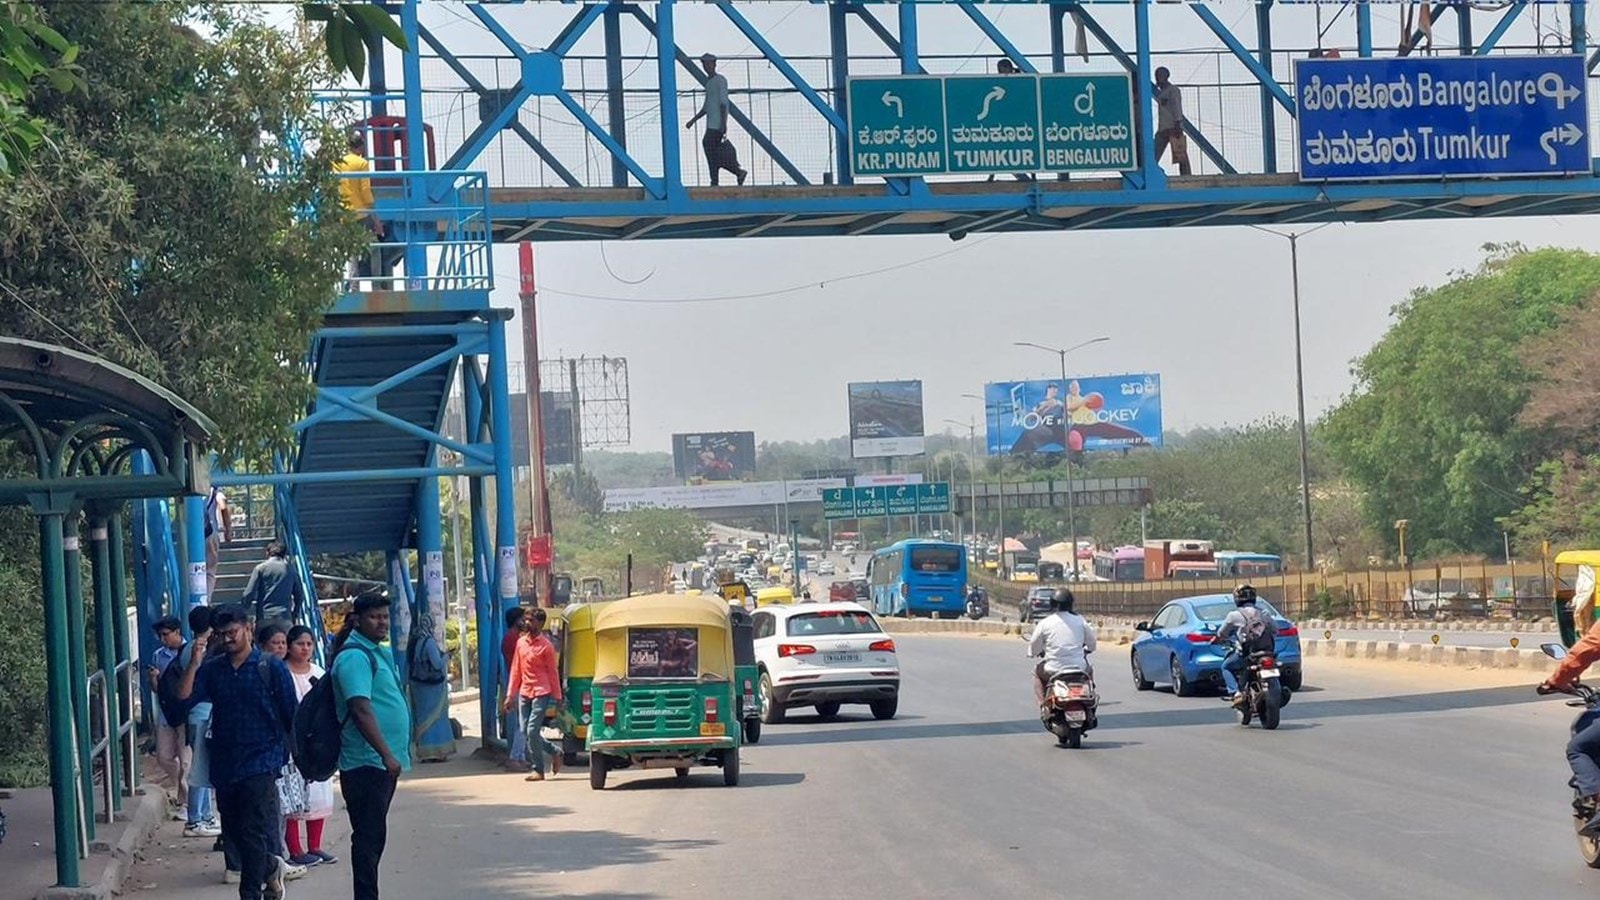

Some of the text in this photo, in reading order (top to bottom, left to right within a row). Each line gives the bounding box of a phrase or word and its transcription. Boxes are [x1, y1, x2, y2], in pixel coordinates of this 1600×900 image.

[1303, 72, 1537, 112] ಬೆಂಗಳೂರು Bangalore
[952, 123, 1034, 143] ತುಮಕೂರು
[1046, 121, 1128, 142] ಬೆಂಗಳೂರು
[1306, 125, 1511, 165] ತುಮಕೂರು Tumkur
[858, 151, 940, 169] KR.PURAM
[954, 149, 1034, 167] TUMKUR
[1047, 147, 1129, 165] BENGALURU
